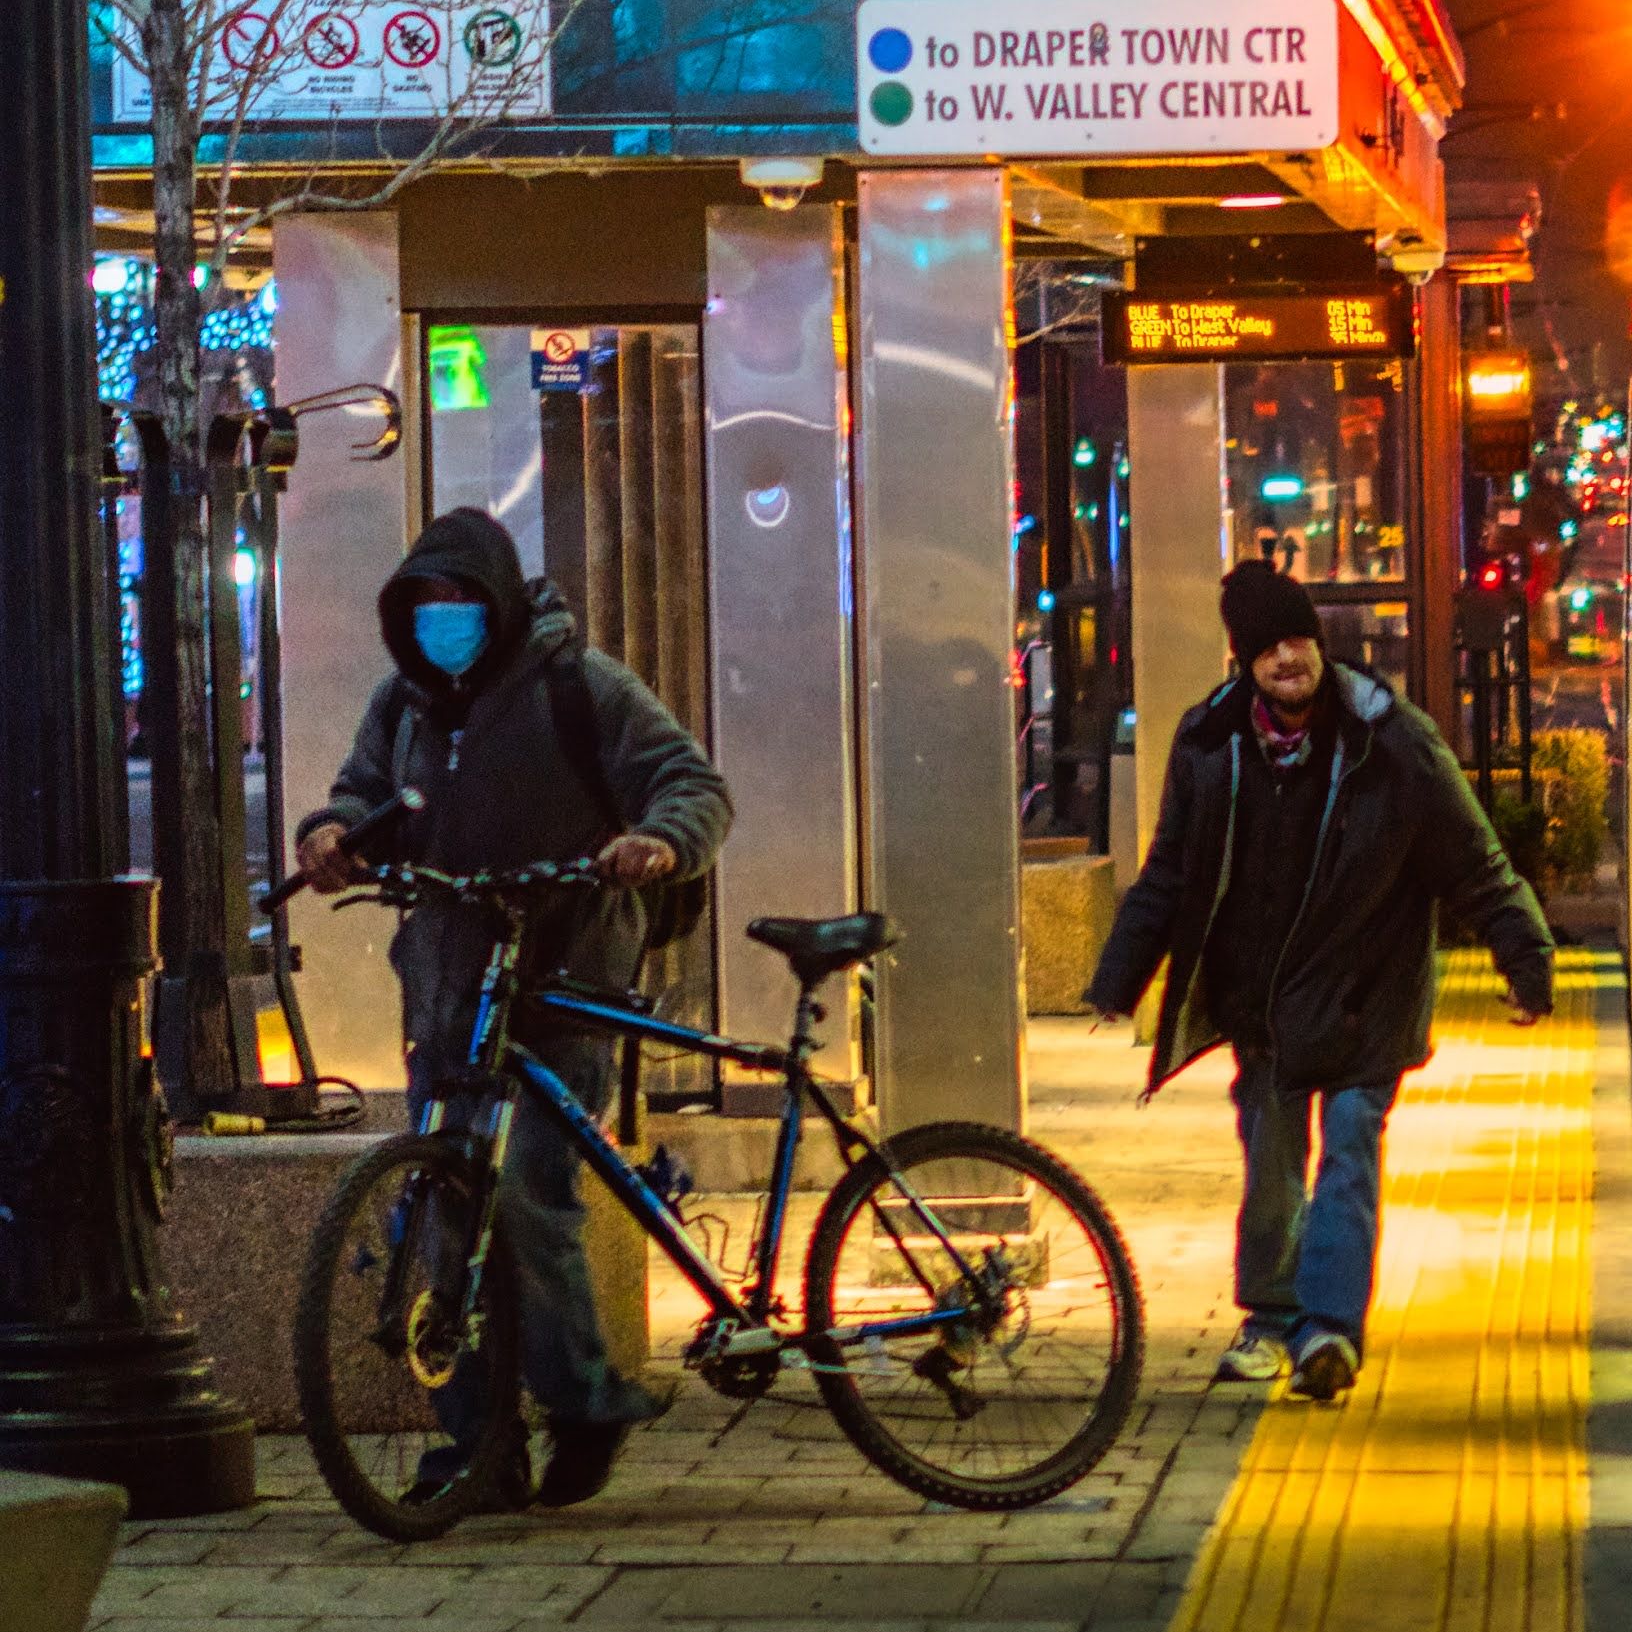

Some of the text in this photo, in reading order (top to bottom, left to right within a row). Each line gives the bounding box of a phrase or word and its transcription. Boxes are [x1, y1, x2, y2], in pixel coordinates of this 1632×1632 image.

[925, 27, 1307, 67] to DRAPER TOWN CTR
[925, 79, 1312, 122] to W. VALLEY CENTRAL
[1128, 299, 1371, 321] BLUE To Draper 05 Min
[1130, 315, 1373, 337] GREEN To West Valley 15 Min
